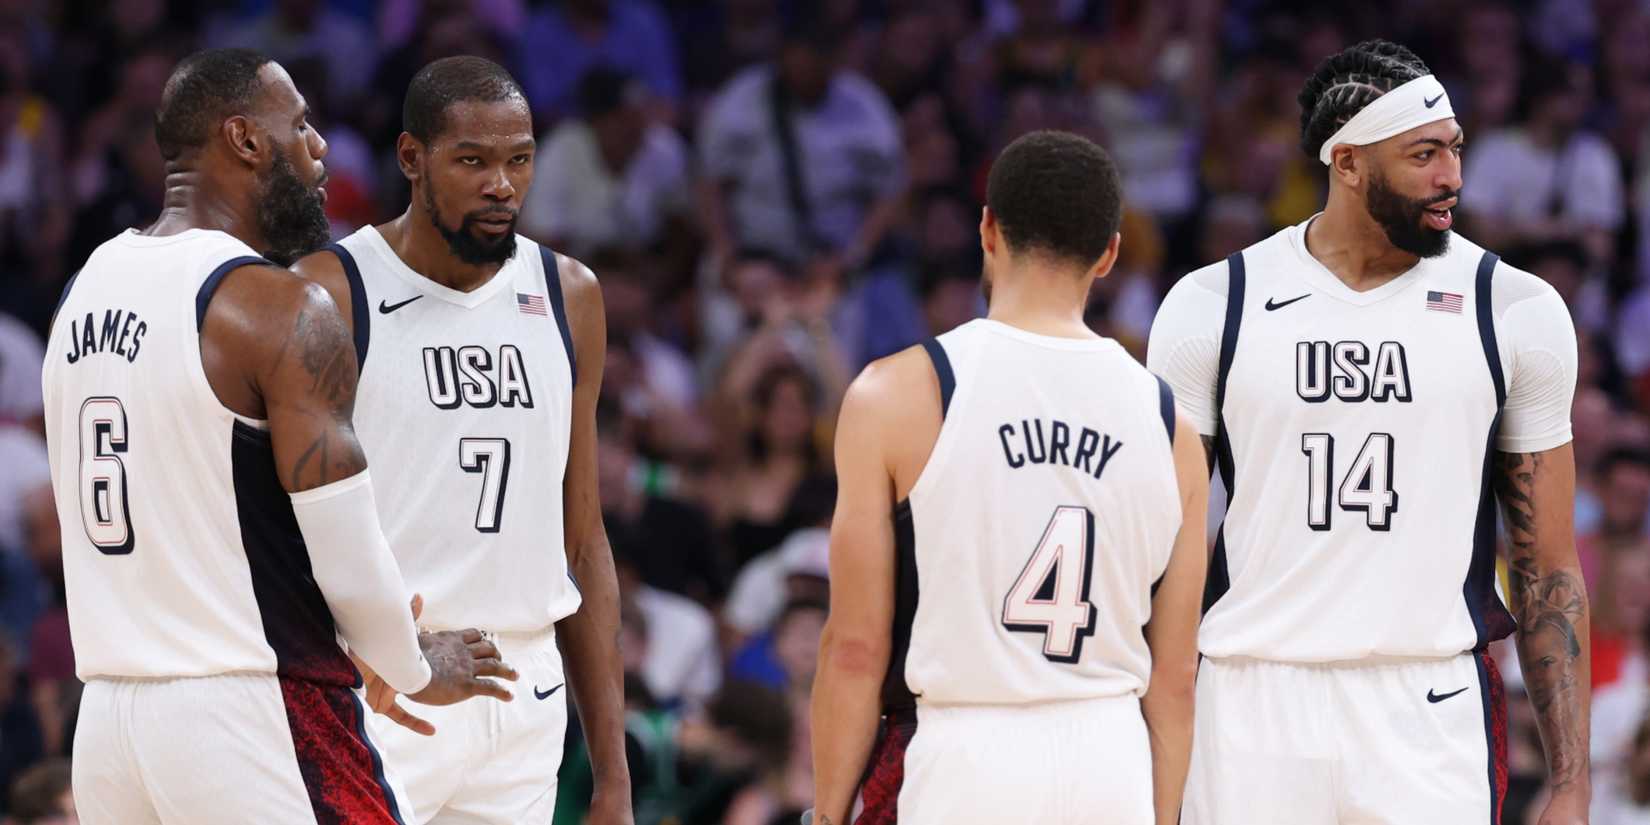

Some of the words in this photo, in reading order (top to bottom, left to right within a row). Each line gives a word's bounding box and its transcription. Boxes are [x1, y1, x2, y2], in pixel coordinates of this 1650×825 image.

[67, 309, 147, 364] JAMES
[1296, 341, 1412, 403] USA
[422, 345, 534, 410] USA
[79, 396, 135, 555] 6
[459, 438, 511, 533] 7
[999, 418, 1122, 479] CURRY
[1302, 432, 1398, 532] 14
[1001, 506, 1097, 664] 4
